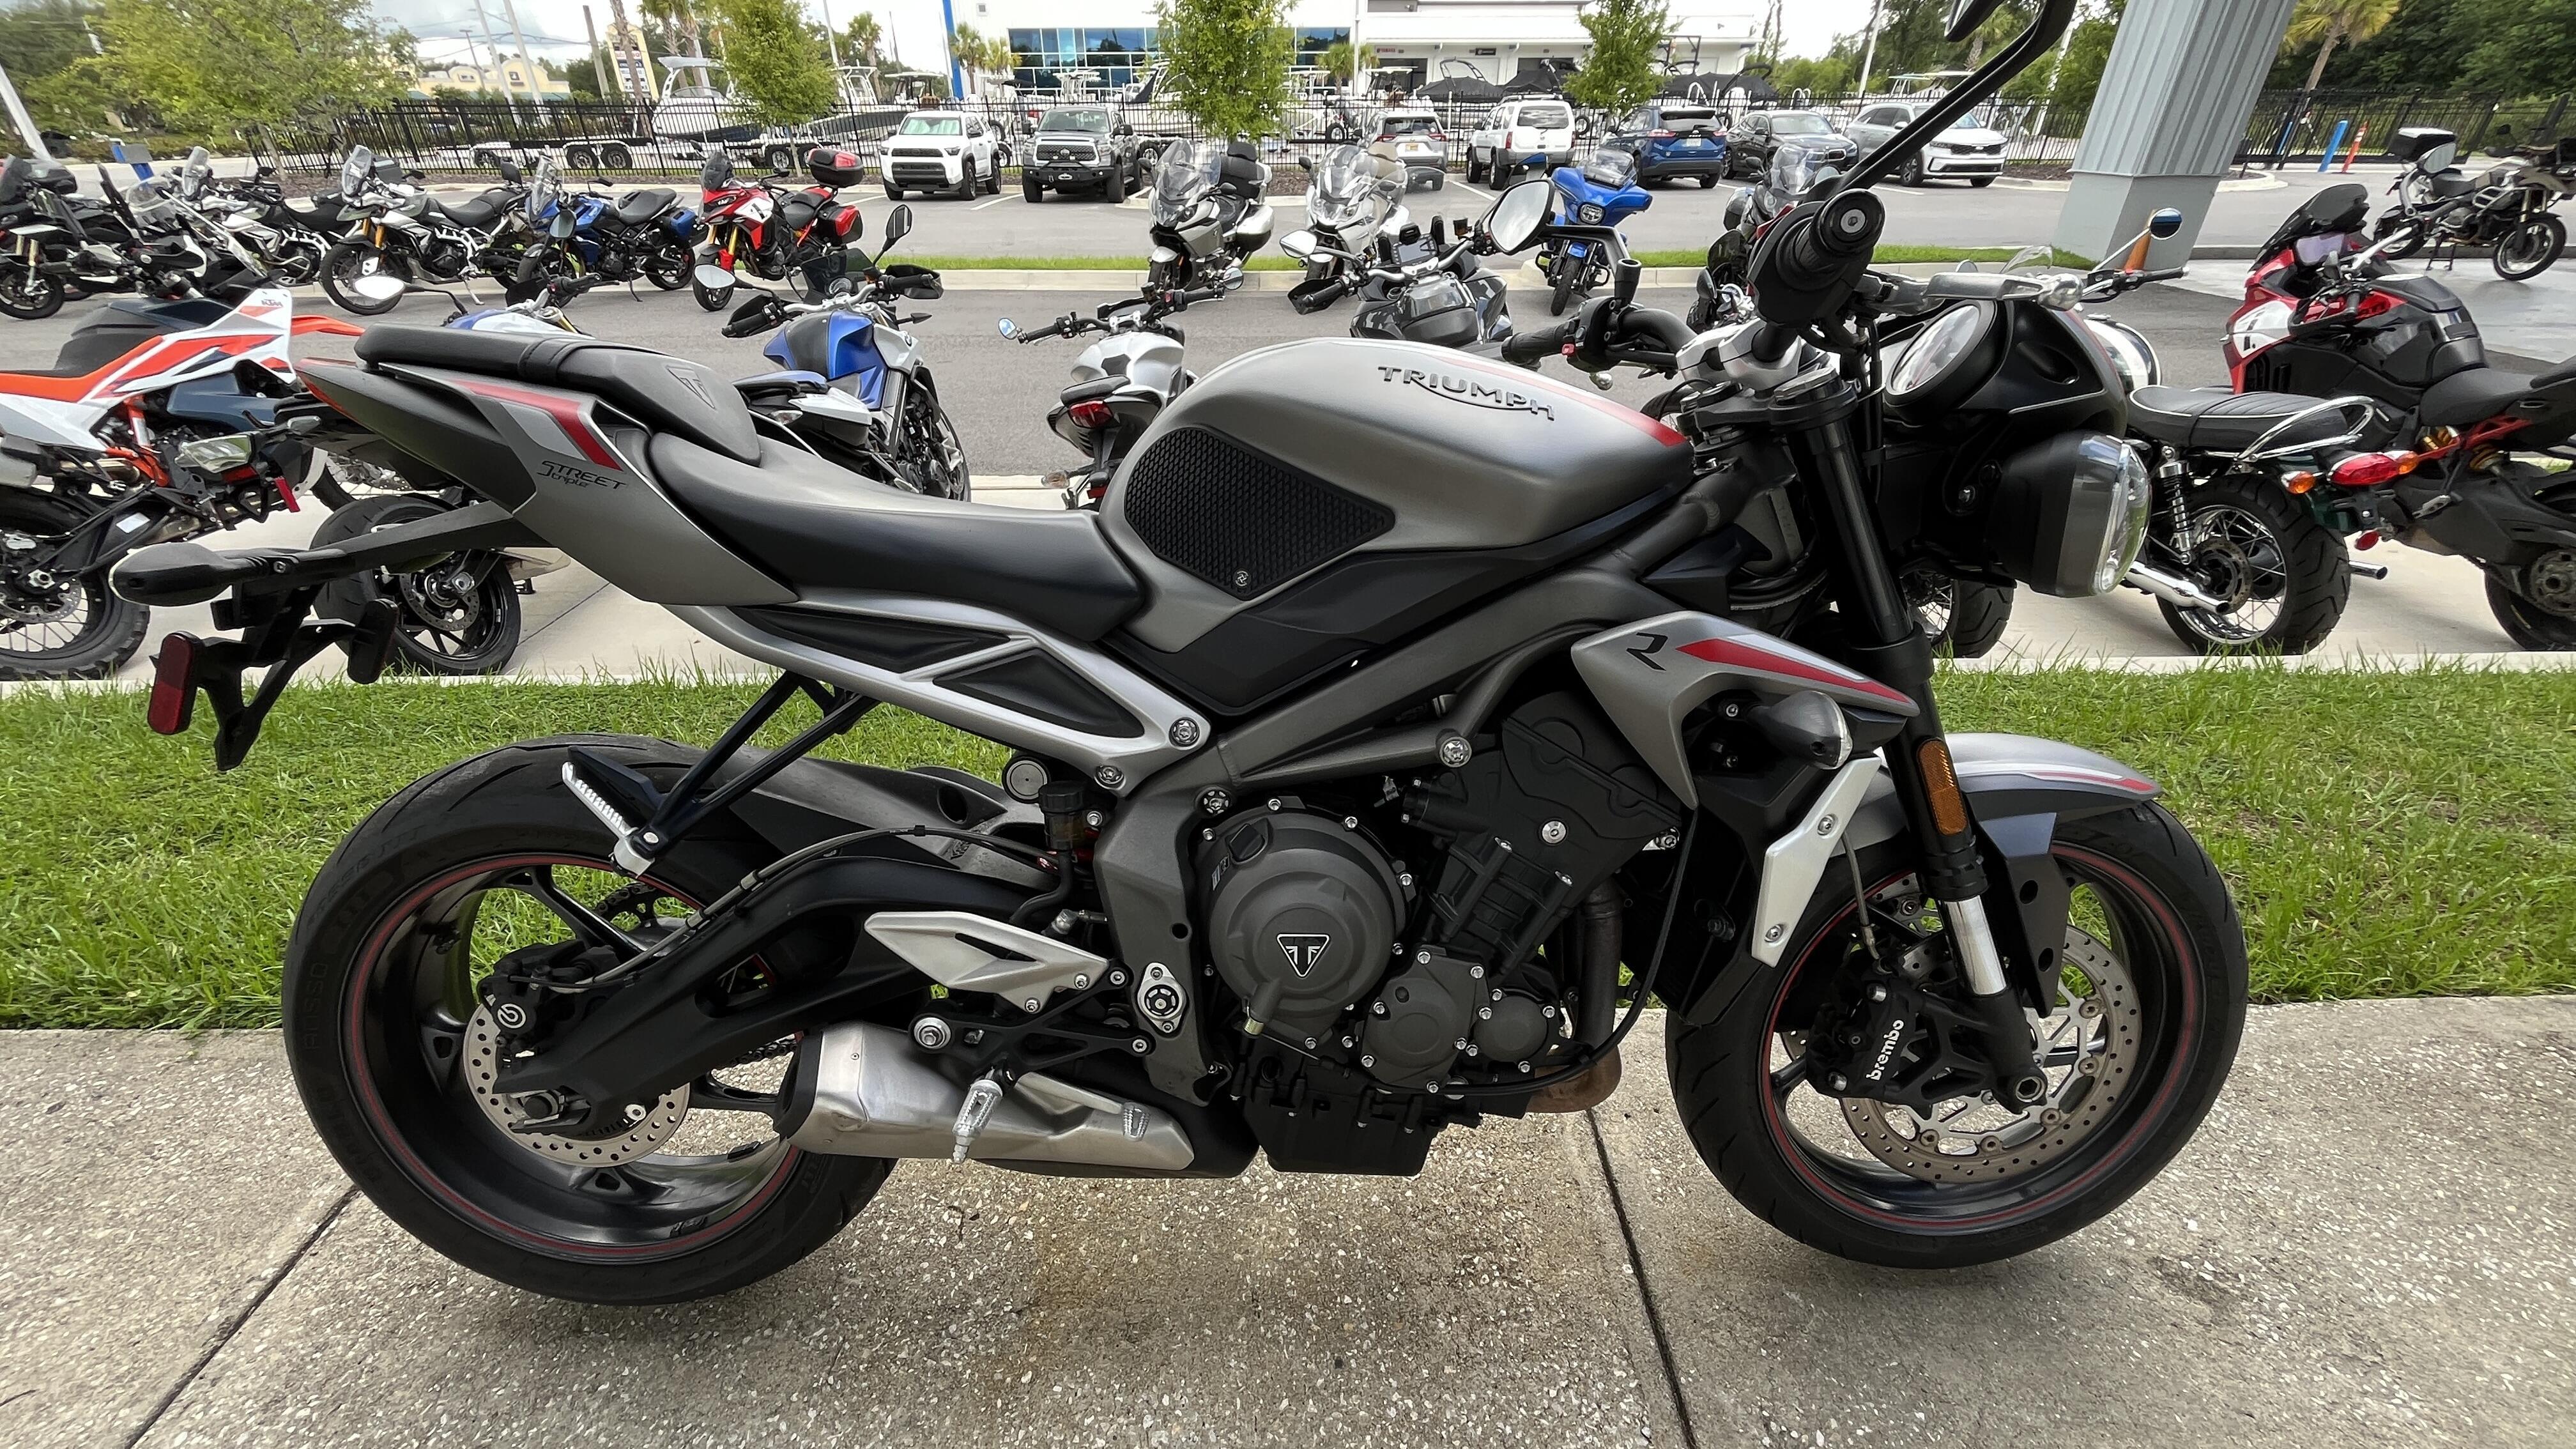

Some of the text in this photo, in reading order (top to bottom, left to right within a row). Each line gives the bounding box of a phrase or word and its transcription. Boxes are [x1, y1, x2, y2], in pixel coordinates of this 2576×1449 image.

[1377, 366, 1554, 422] TRIUMPH
[537, 460, 627, 490] STREET
[1866, 1020, 1905, 1081] brembo
